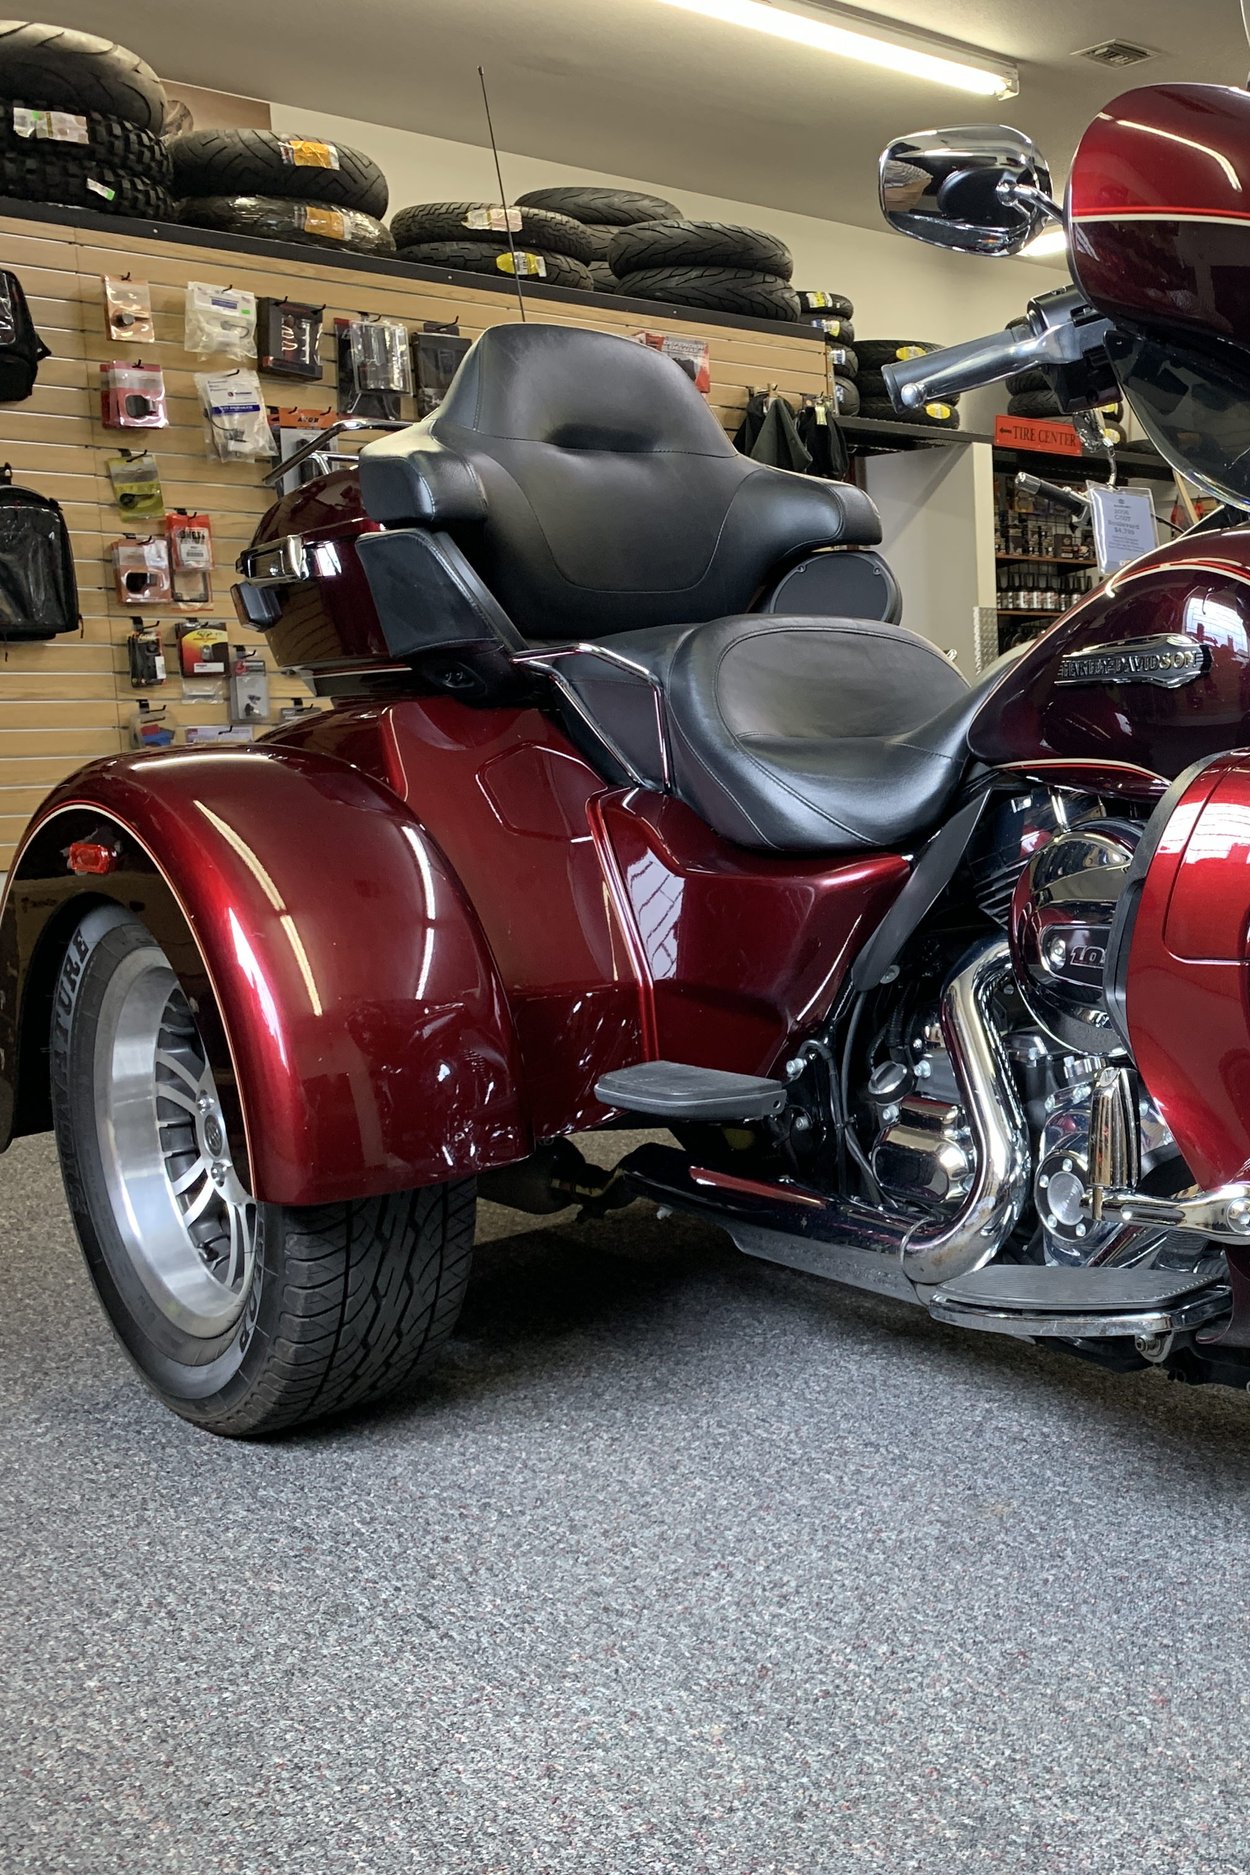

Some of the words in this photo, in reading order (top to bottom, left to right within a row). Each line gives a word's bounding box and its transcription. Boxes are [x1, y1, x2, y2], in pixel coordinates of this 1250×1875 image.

[1013, 426, 1035, 442] TIRE
[1039, 430, 1076, 447] CENTER
[1070, 945, 1106, 969] 10
